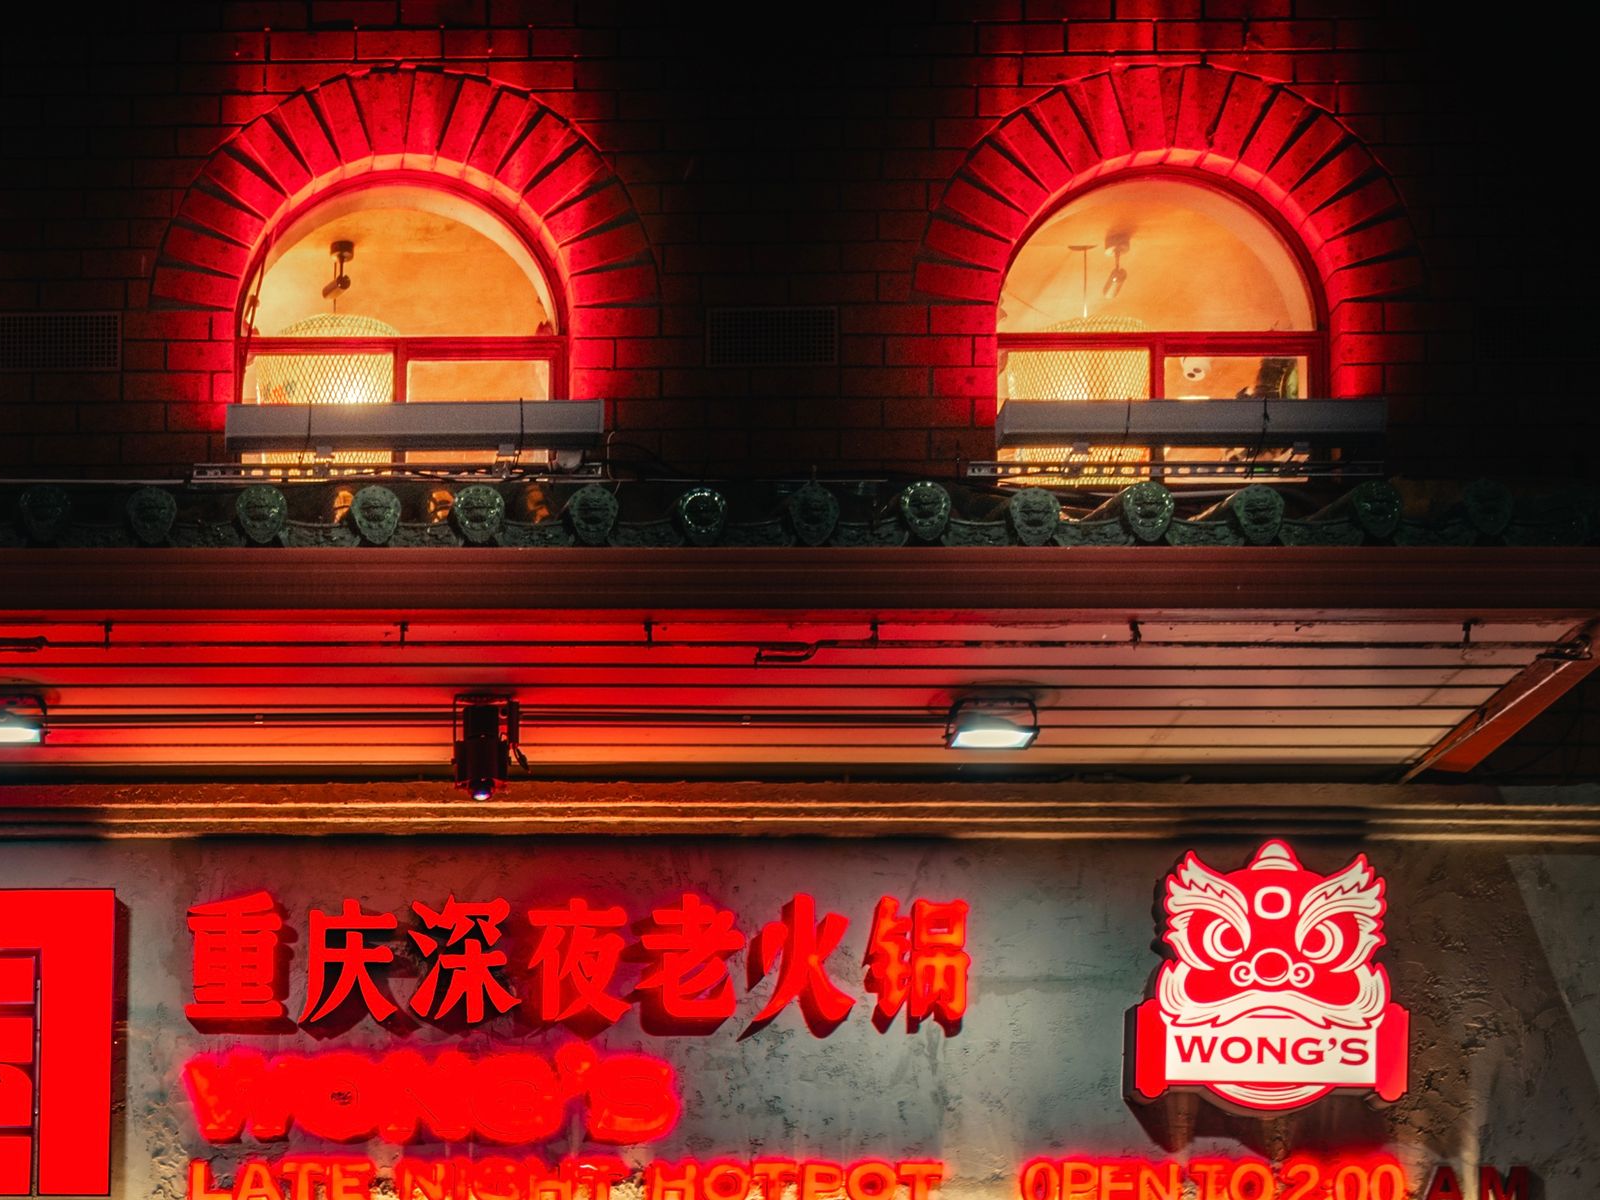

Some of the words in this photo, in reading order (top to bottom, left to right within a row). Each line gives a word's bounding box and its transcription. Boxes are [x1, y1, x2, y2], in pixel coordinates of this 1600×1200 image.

[184, 889, 971, 1034] 重庆深夜老火锅
[184, 1046, 680, 1142] WONG'S
[1173, 1035, 1370, 1066] WONG'S
